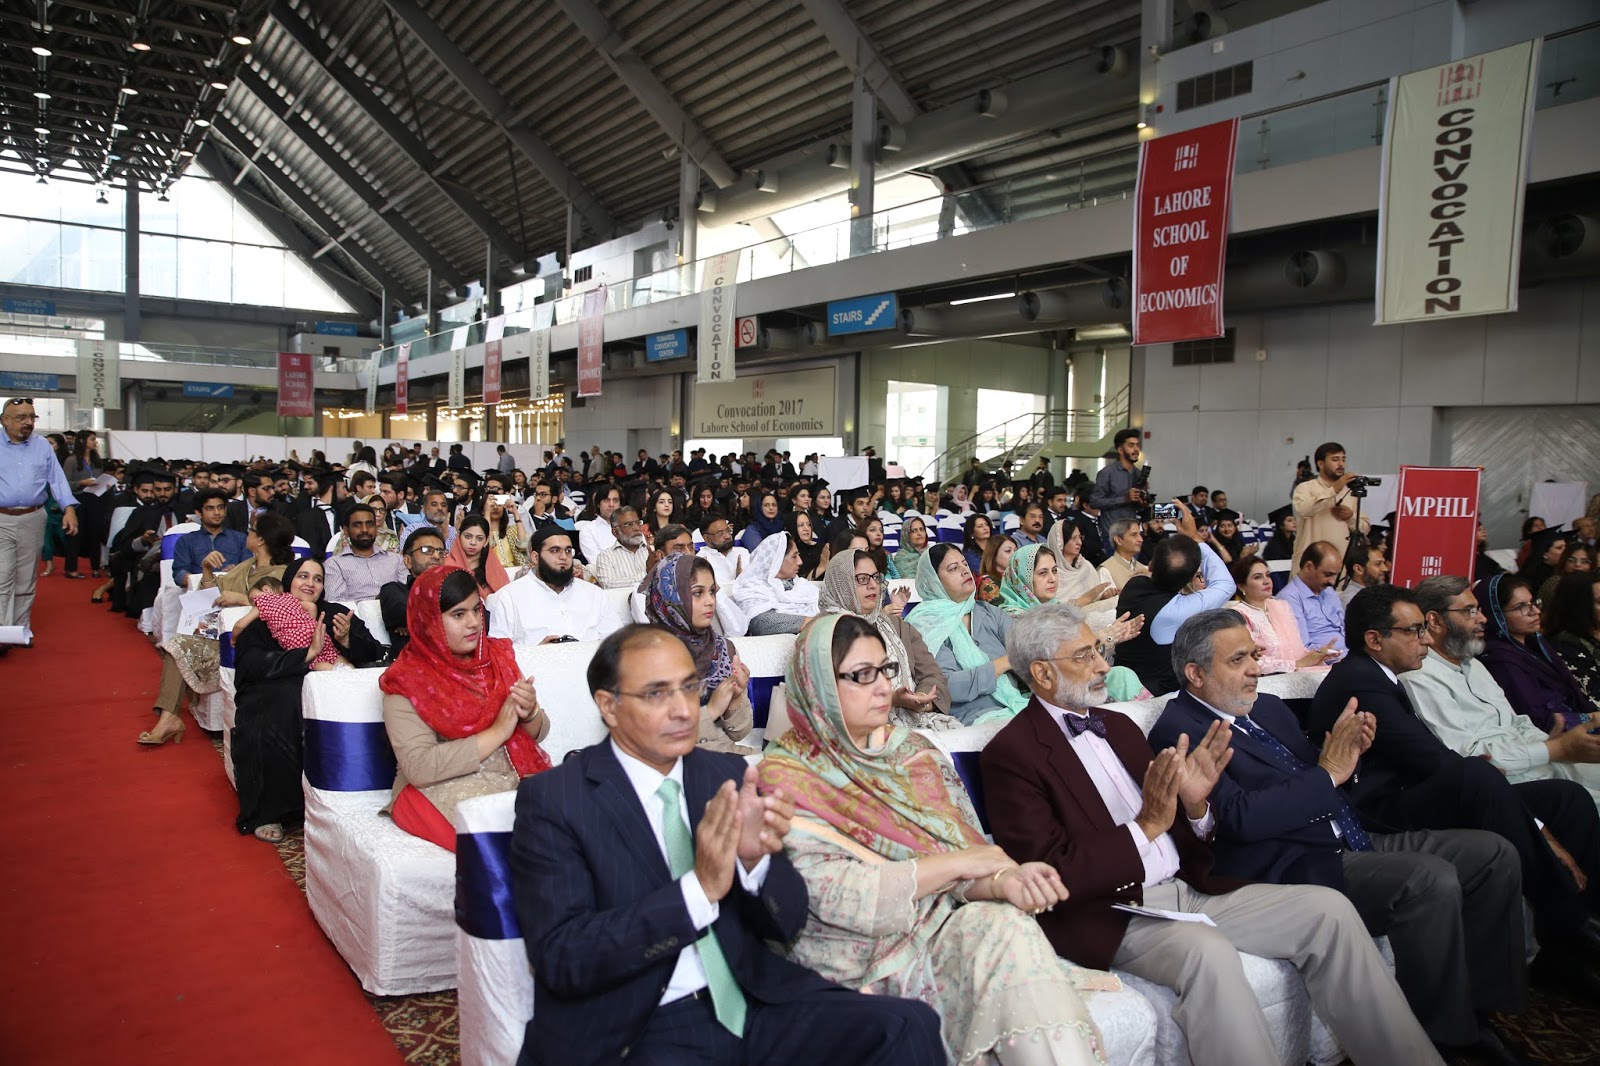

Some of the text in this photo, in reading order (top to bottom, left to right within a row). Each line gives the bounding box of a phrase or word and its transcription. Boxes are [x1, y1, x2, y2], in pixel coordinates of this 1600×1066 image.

[1154, 186, 1212, 216] LAHORE
[1425, 108, 1475, 314] CONVOCATION
[1153, 220, 1209, 248] SCHOOL
[1170, 255, 1190, 277] OF
[1140, 283, 1218, 313] ECONOMICS
[711, 277, 724, 380] CONVOCATION
[833, 310, 863, 325] STAIRS
[654, 341, 679, 351] CONVENTION
[659, 349, 675, 357] CENTER
[717, 399, 804, 419] Convocation 2017
[701, 417, 824, 434] Lahore School of Economics
[1401, 496, 1475, 518] MPHIL
